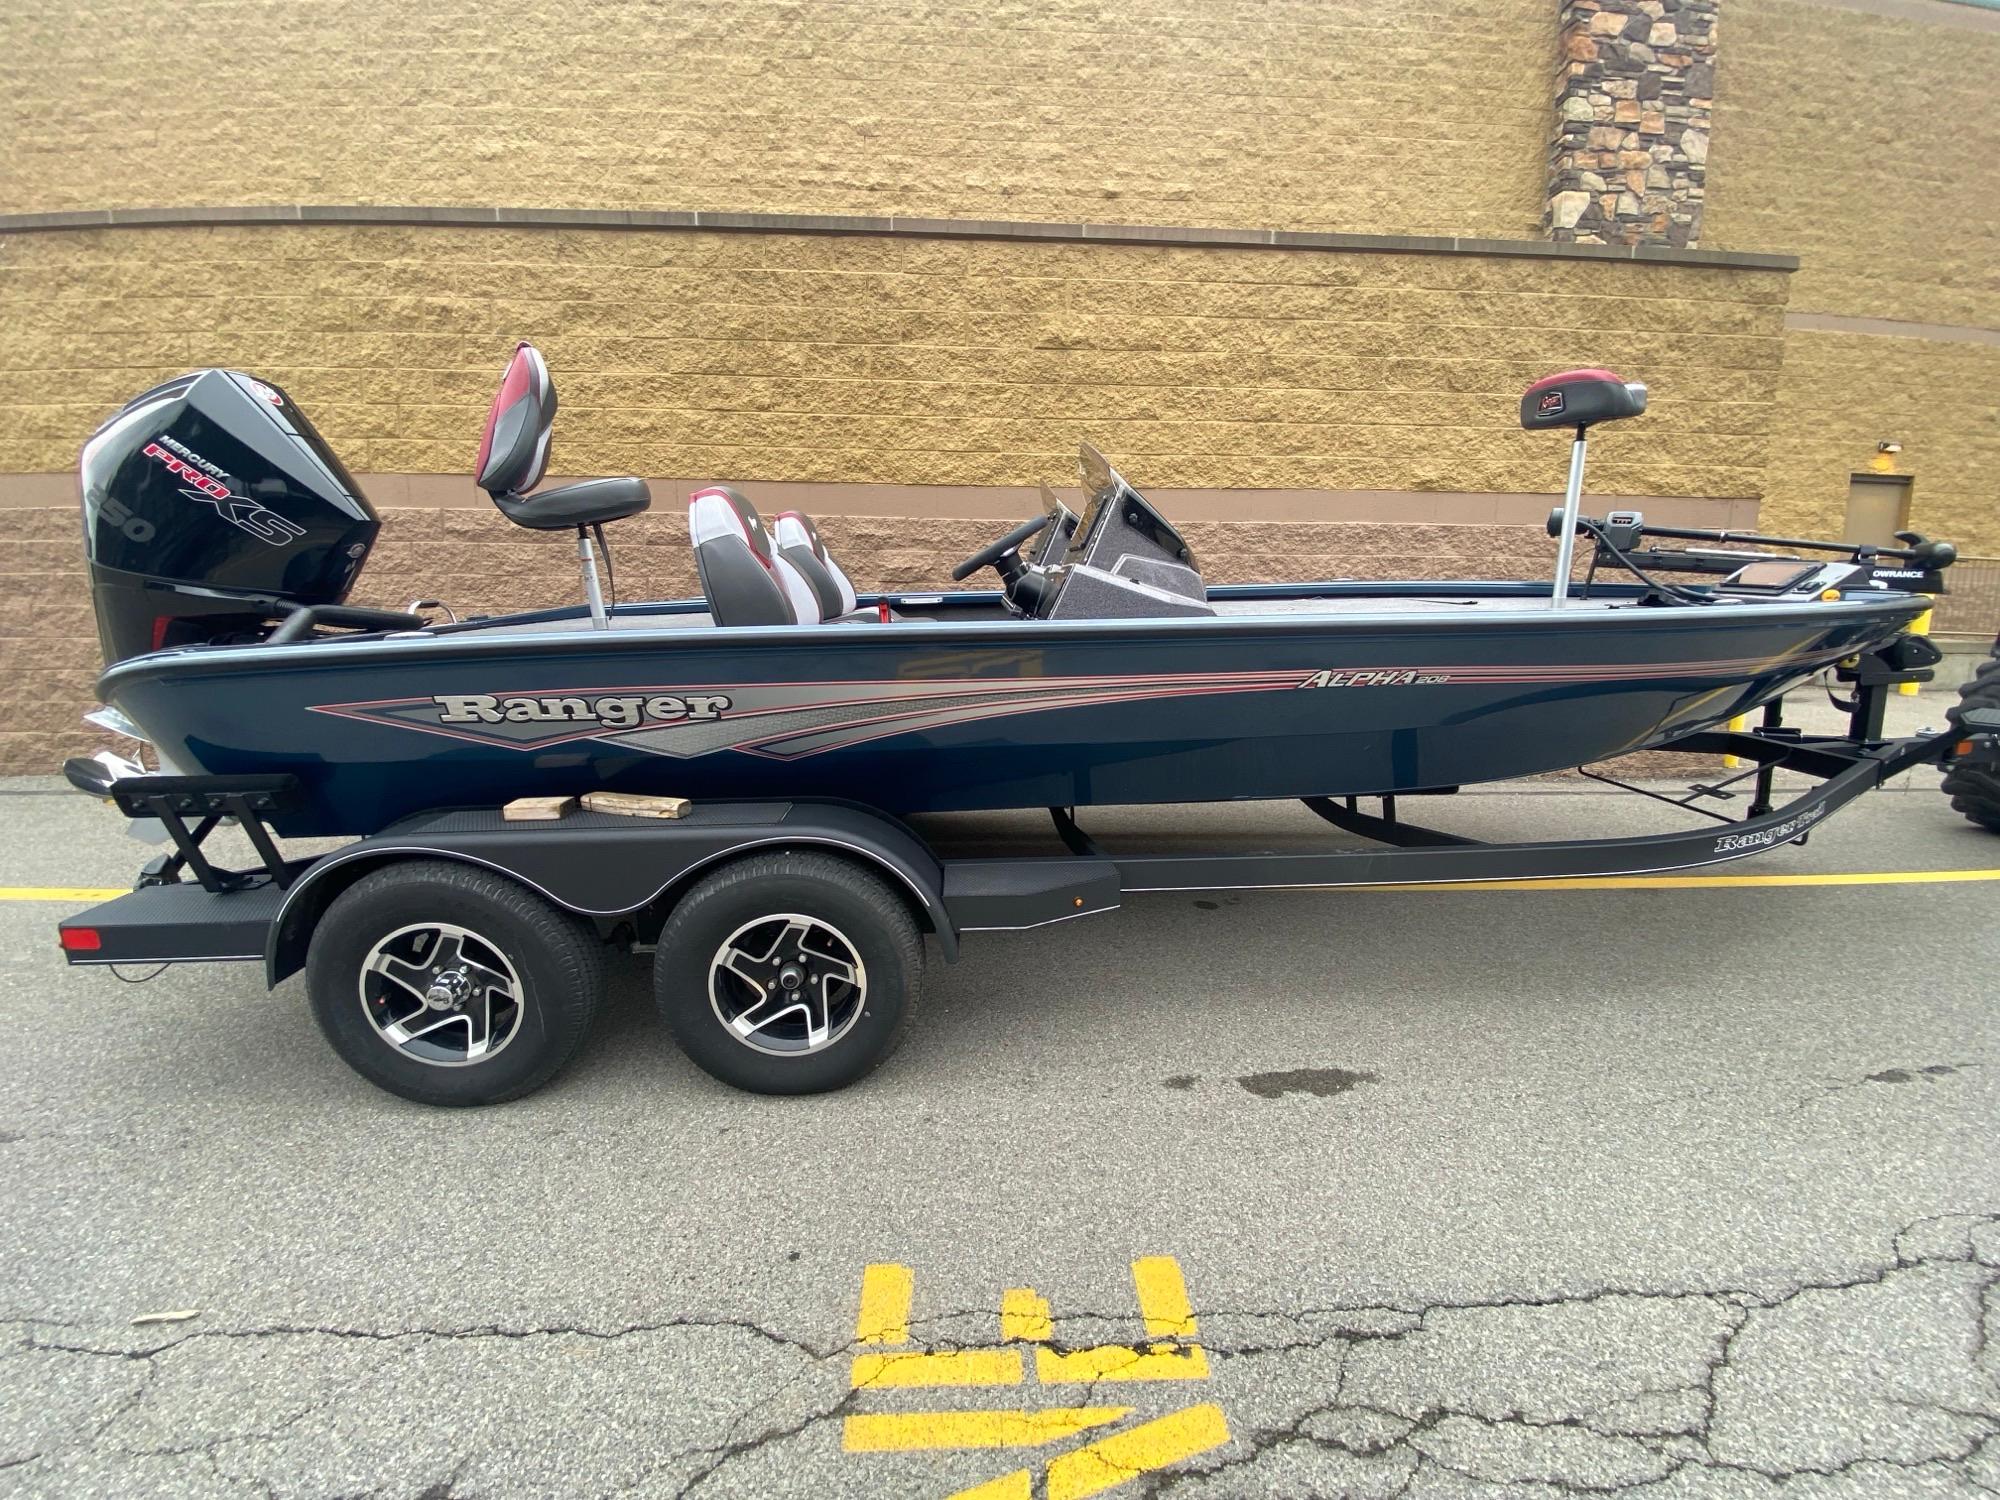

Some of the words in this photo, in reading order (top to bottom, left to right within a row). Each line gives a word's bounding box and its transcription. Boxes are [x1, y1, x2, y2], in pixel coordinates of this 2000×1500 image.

[143, 443, 232, 500] PRO
[158, 434, 231, 480] MERCURY
[178, 489, 307, 546] XS
[1299, 669, 1418, 689] ALPHA
[432, 693, 734, 731] Ranger
[1714, 820, 1796, 853] Ranger
